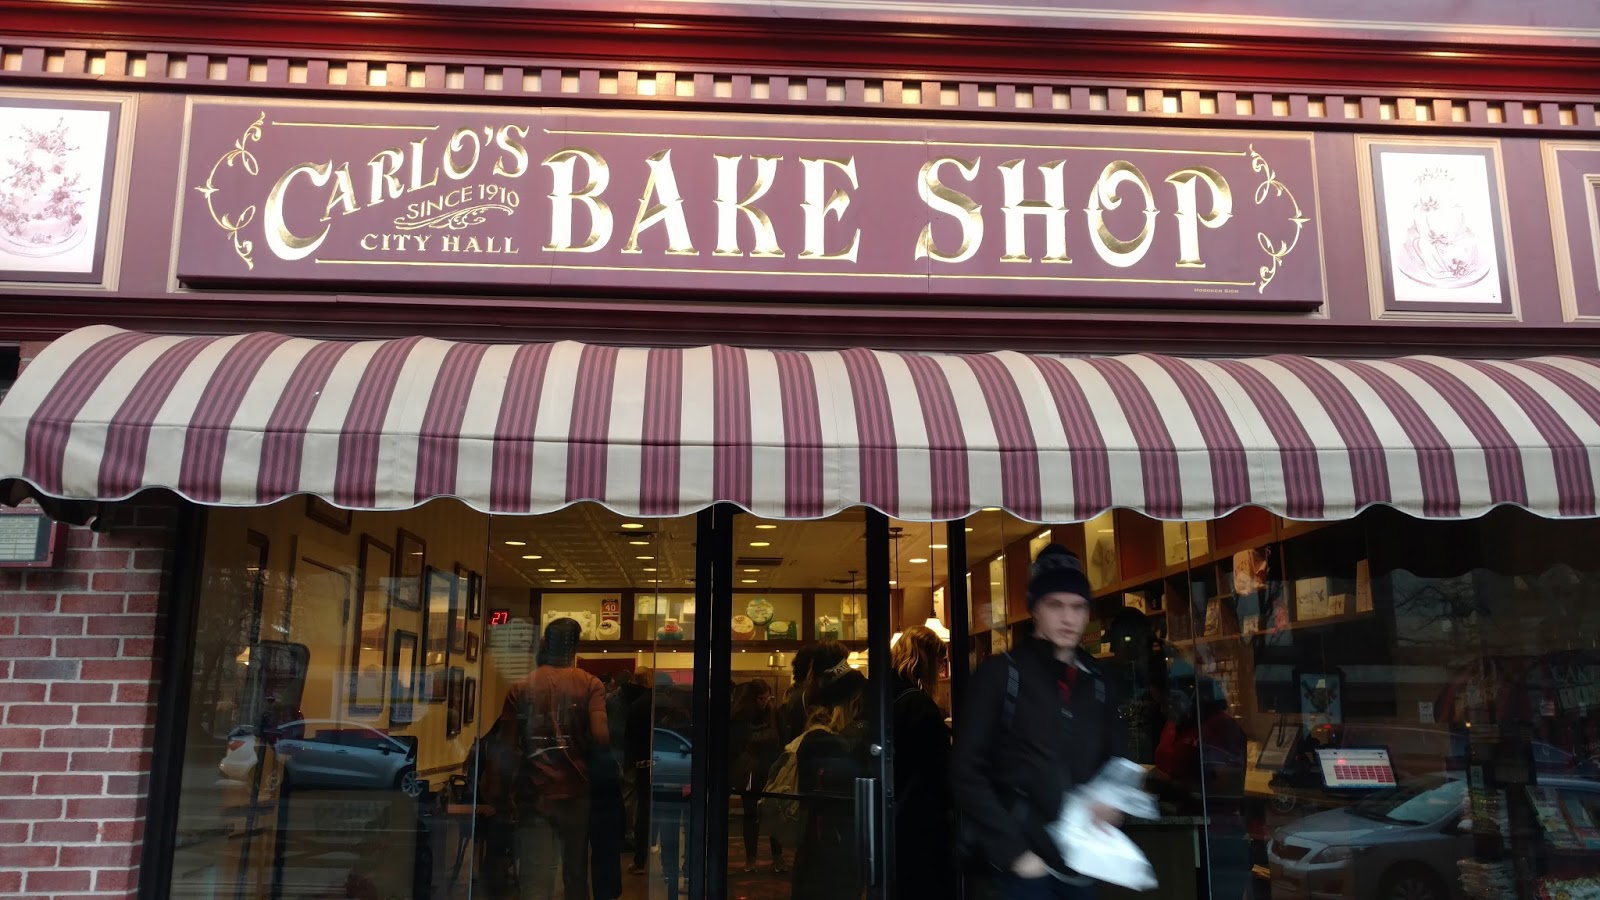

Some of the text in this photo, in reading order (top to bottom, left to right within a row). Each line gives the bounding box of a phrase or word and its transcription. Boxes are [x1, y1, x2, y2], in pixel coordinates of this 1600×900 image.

[264, 125, 529, 261] CARLO'S
[406, 184, 520, 219] SINCE 1910
[541, 149, 1234, 268] BAKE SHOP
[360, 233, 519, 254] CITY HALL
[491, 612, 508, 625] 27
[605, 604, 616, 612] 40
